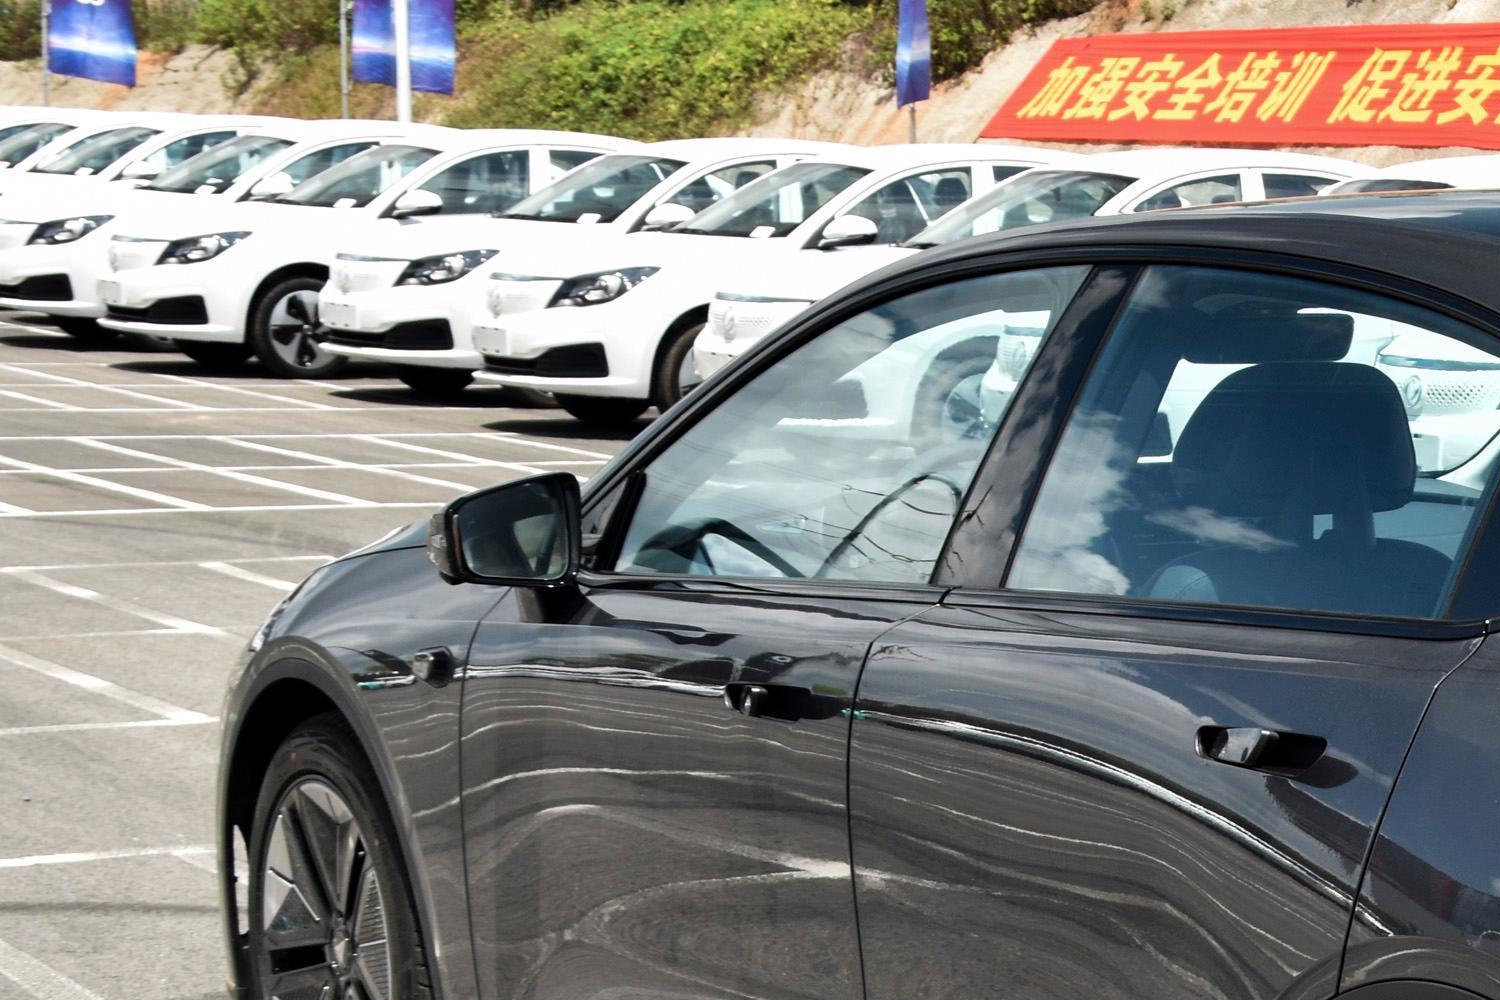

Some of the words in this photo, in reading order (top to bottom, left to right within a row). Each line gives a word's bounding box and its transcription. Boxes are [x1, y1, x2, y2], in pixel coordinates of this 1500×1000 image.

[1016, 49, 1336, 123] 加强安全培训
